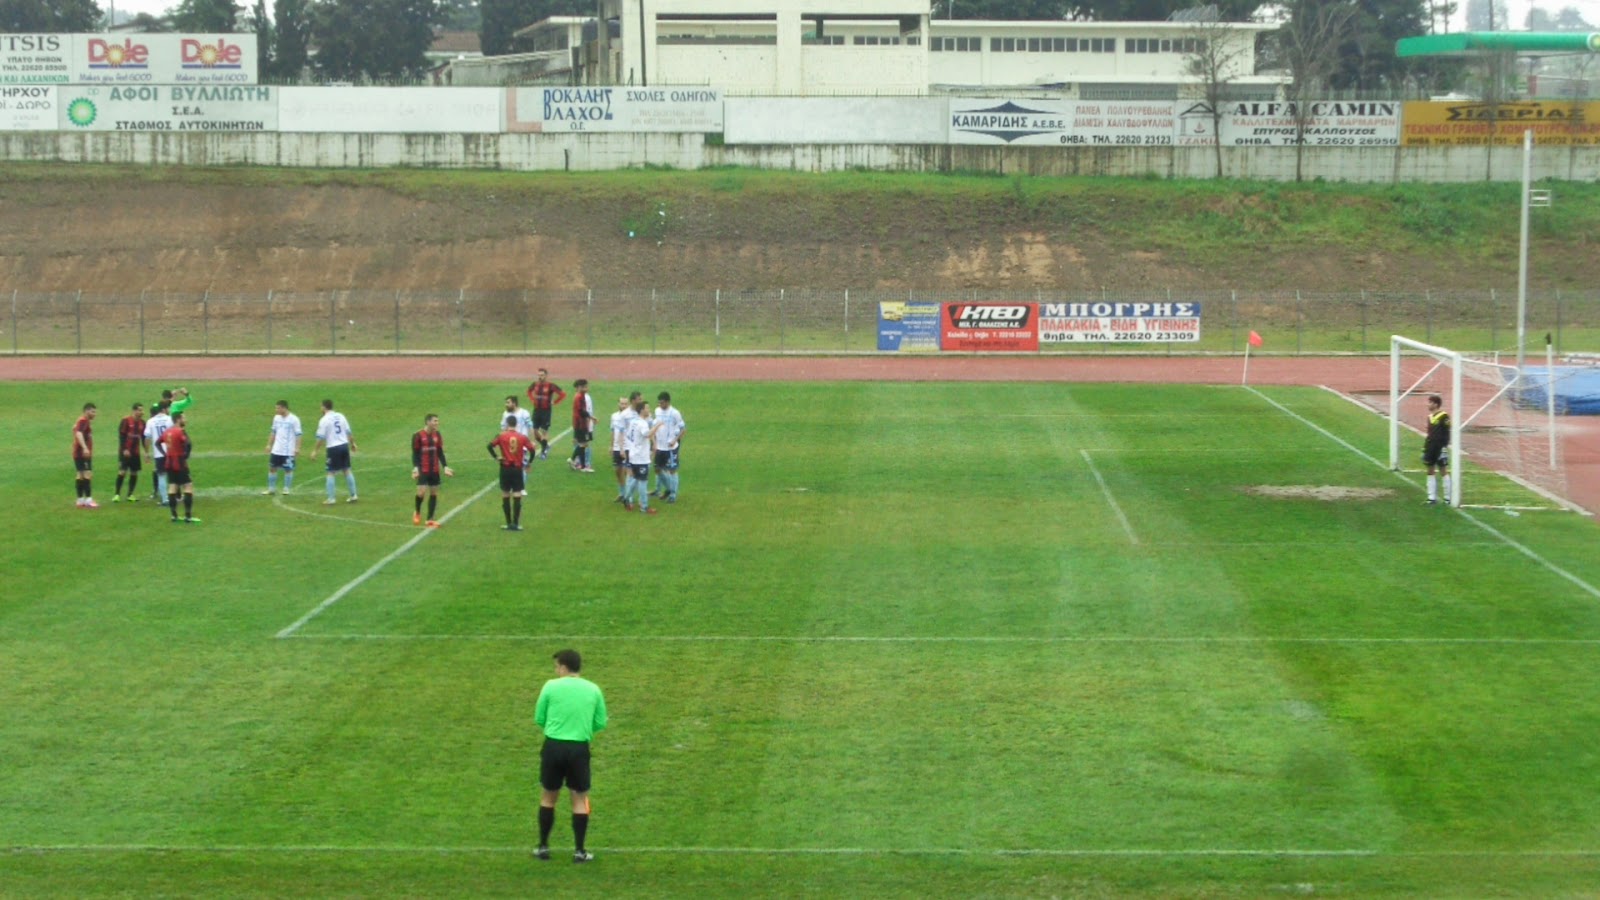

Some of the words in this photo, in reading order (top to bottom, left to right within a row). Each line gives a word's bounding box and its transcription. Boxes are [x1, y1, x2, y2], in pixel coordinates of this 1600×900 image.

[0, 35, 60, 51] TSIS
[88, 37, 149, 63] Dole
[181, 37, 242, 63] Dole
[0, 87, 50, 97] ΗΡΧΟΥ
[110, 87, 158, 101] ΑΦΟΙ
[171, 87, 270, 101] ΒΥΛΛΙΩΤΗ
[626, 91, 666, 101] ΣΧΟΛΕΣ
[670, 91, 717, 101] ΟΔΗΓΩΝ
[172, 107, 205, 115] Σ.Ε.Α.
[1233, 103, 1298, 116] ALFA
[1311, 103, 1394, 116] CAMIN
[116, 121, 172, 130] ΣΤΑΘΜΟΣ
[179, 121, 264, 130] ΑΥΤΟΚΙΝΗΤΩΝ
[952, 116, 1029, 128] ΚΑΜΑΡΙΔΗΣ
[1060, 135, 1088, 144] ΘΗΒΑ:
[1092, 135, 1113, 144] ΤΗΛ.
[1115, 135, 1142, 144] 22620
[1145, 135, 1171, 144] 23123
[1045, 303, 1194, 316] ΜΠΟΓΡΗΣ
[1041, 319, 1101, 331] ΠΛΑΚΑΚΙΑ
[1110, 319, 1138, 331] ΕΙΔΗ
[1144, 319, 1198, 331] ΥΓΙΕΙΝΗΣ
[1115, 332, 1152, 340] 22620
[1156, 332, 1194, 340] 23309
[334, 421, 341, 434] 5
